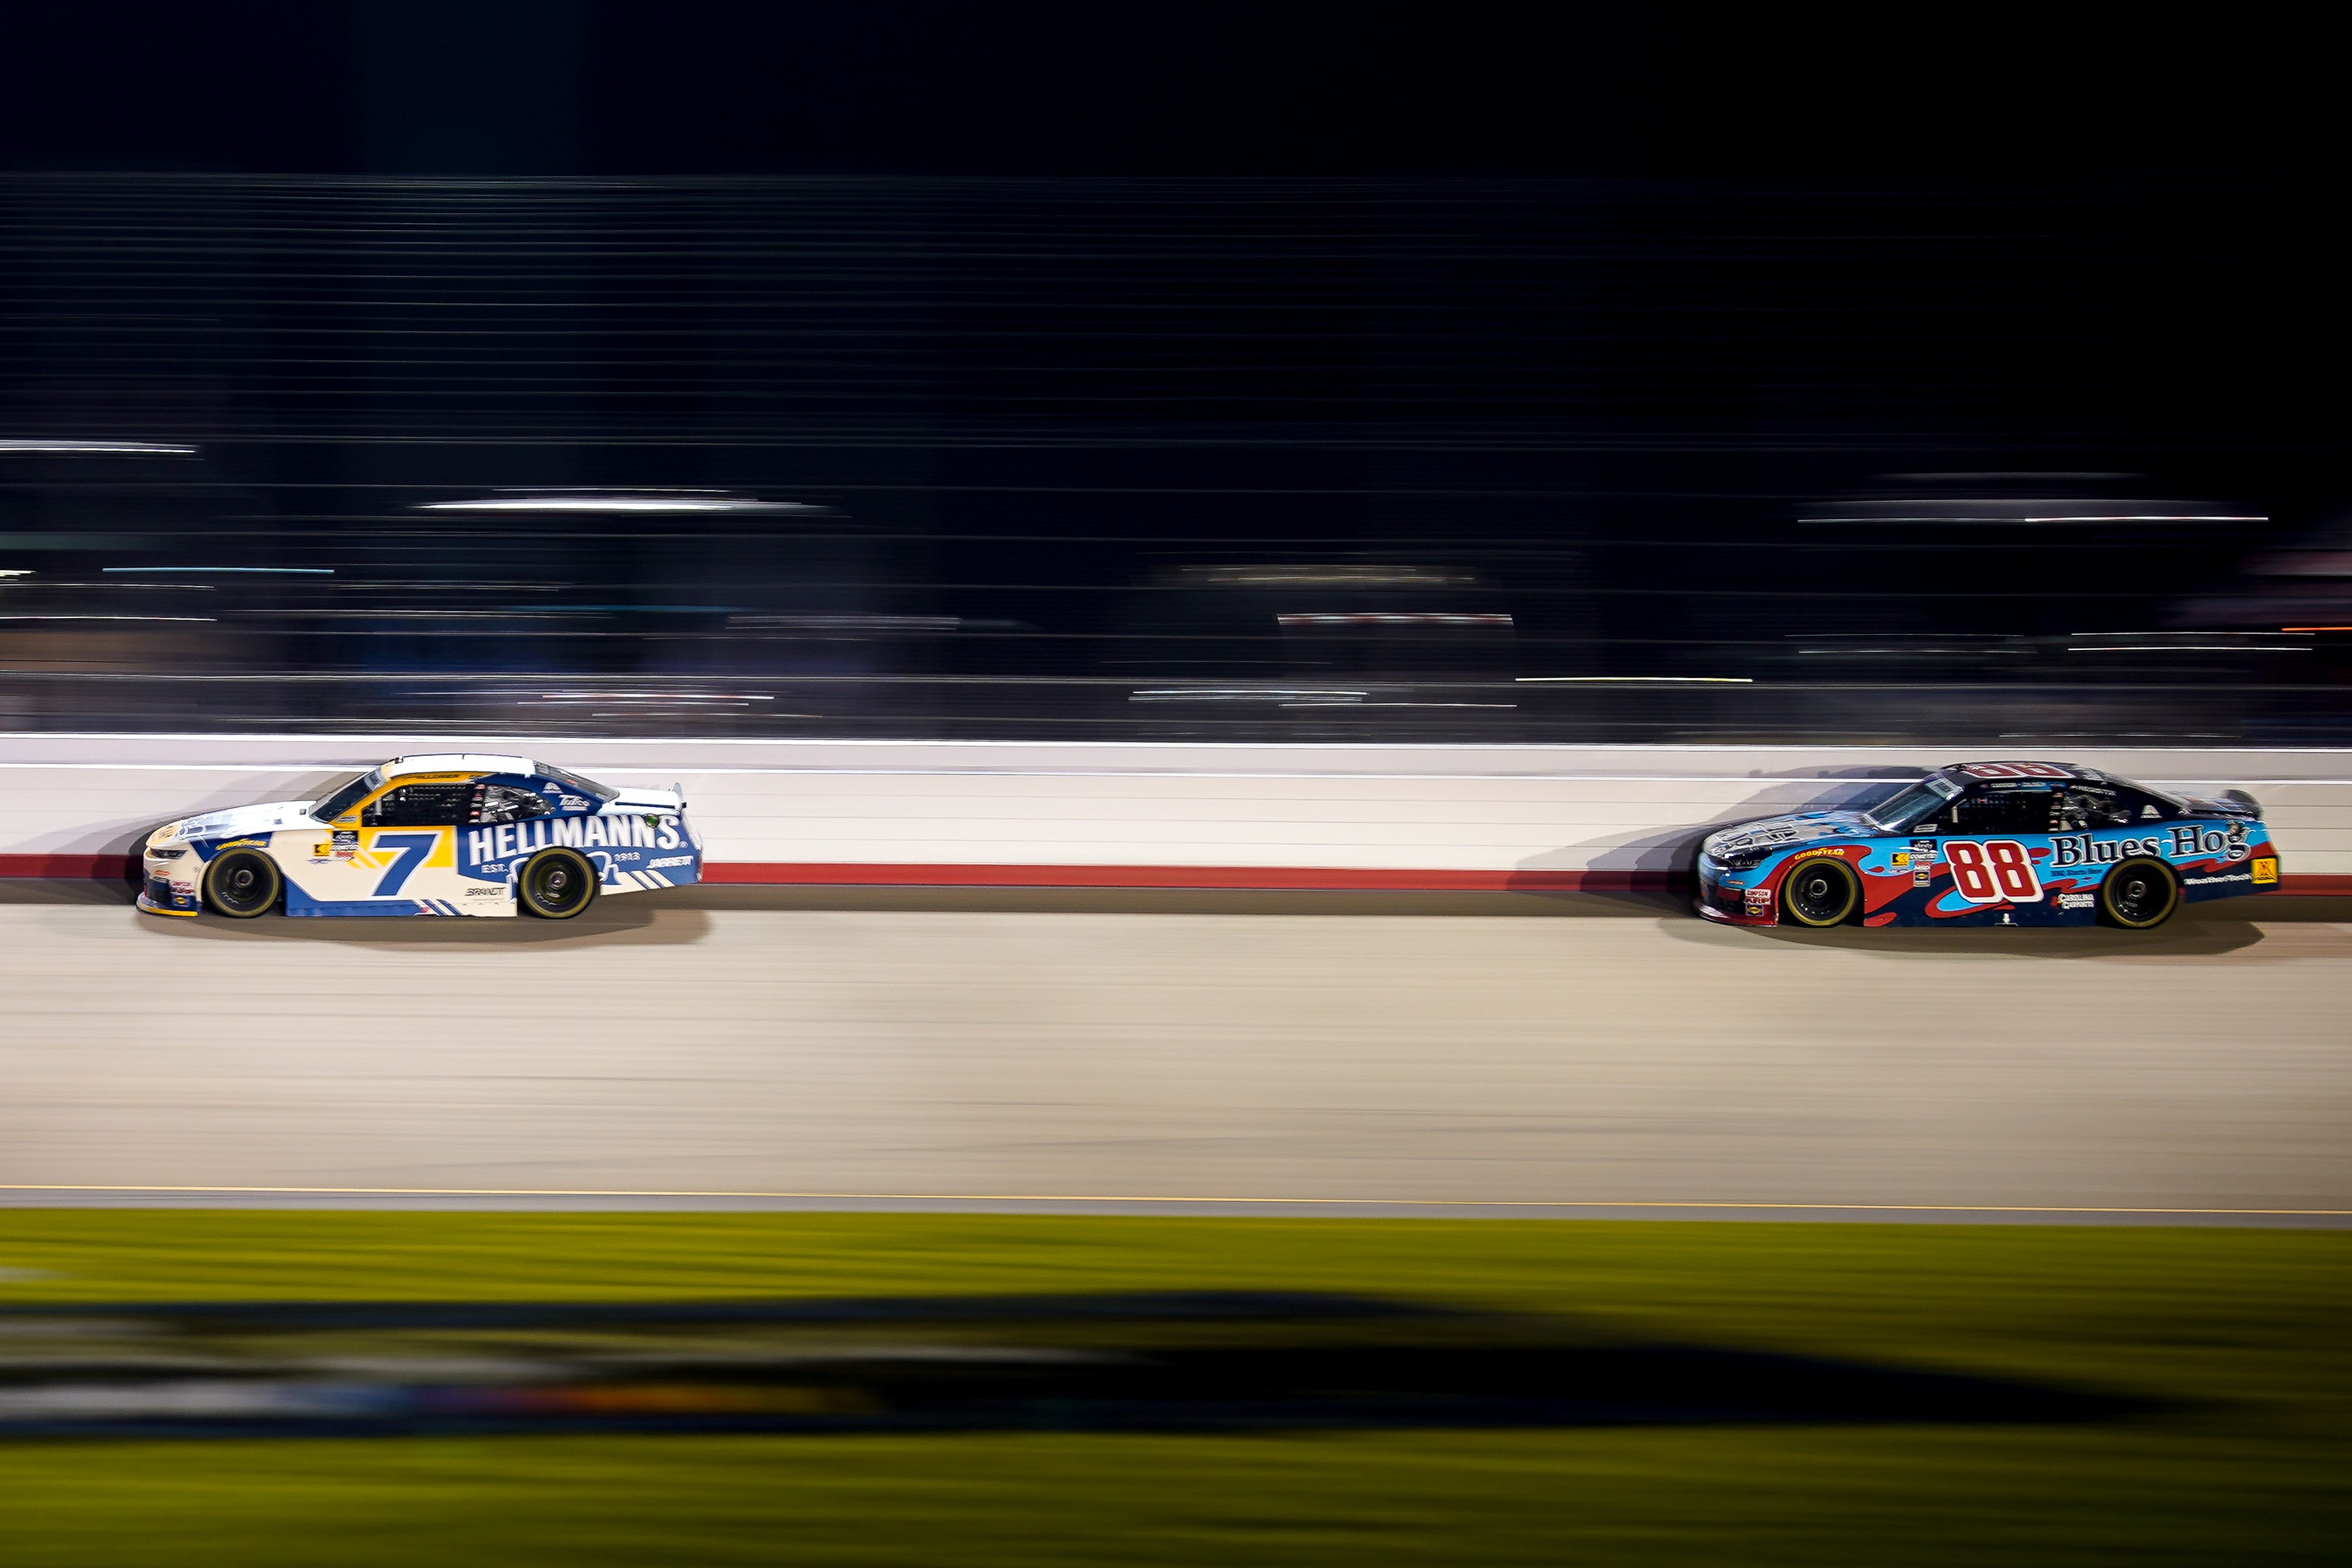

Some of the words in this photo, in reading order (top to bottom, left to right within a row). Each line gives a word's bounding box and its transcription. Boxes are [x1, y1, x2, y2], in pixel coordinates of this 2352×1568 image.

[468, 814, 680, 866] HELLMANNS
[1795, 848, 1844, 860] GOODYEAR
[2048, 833, 2161, 868] Blues
[2166, 824, 2251, 861] Hog
[370, 832, 440, 898] 7
[482, 864, 508, 874] EST.
[1944, 840, 2043, 903] 88
